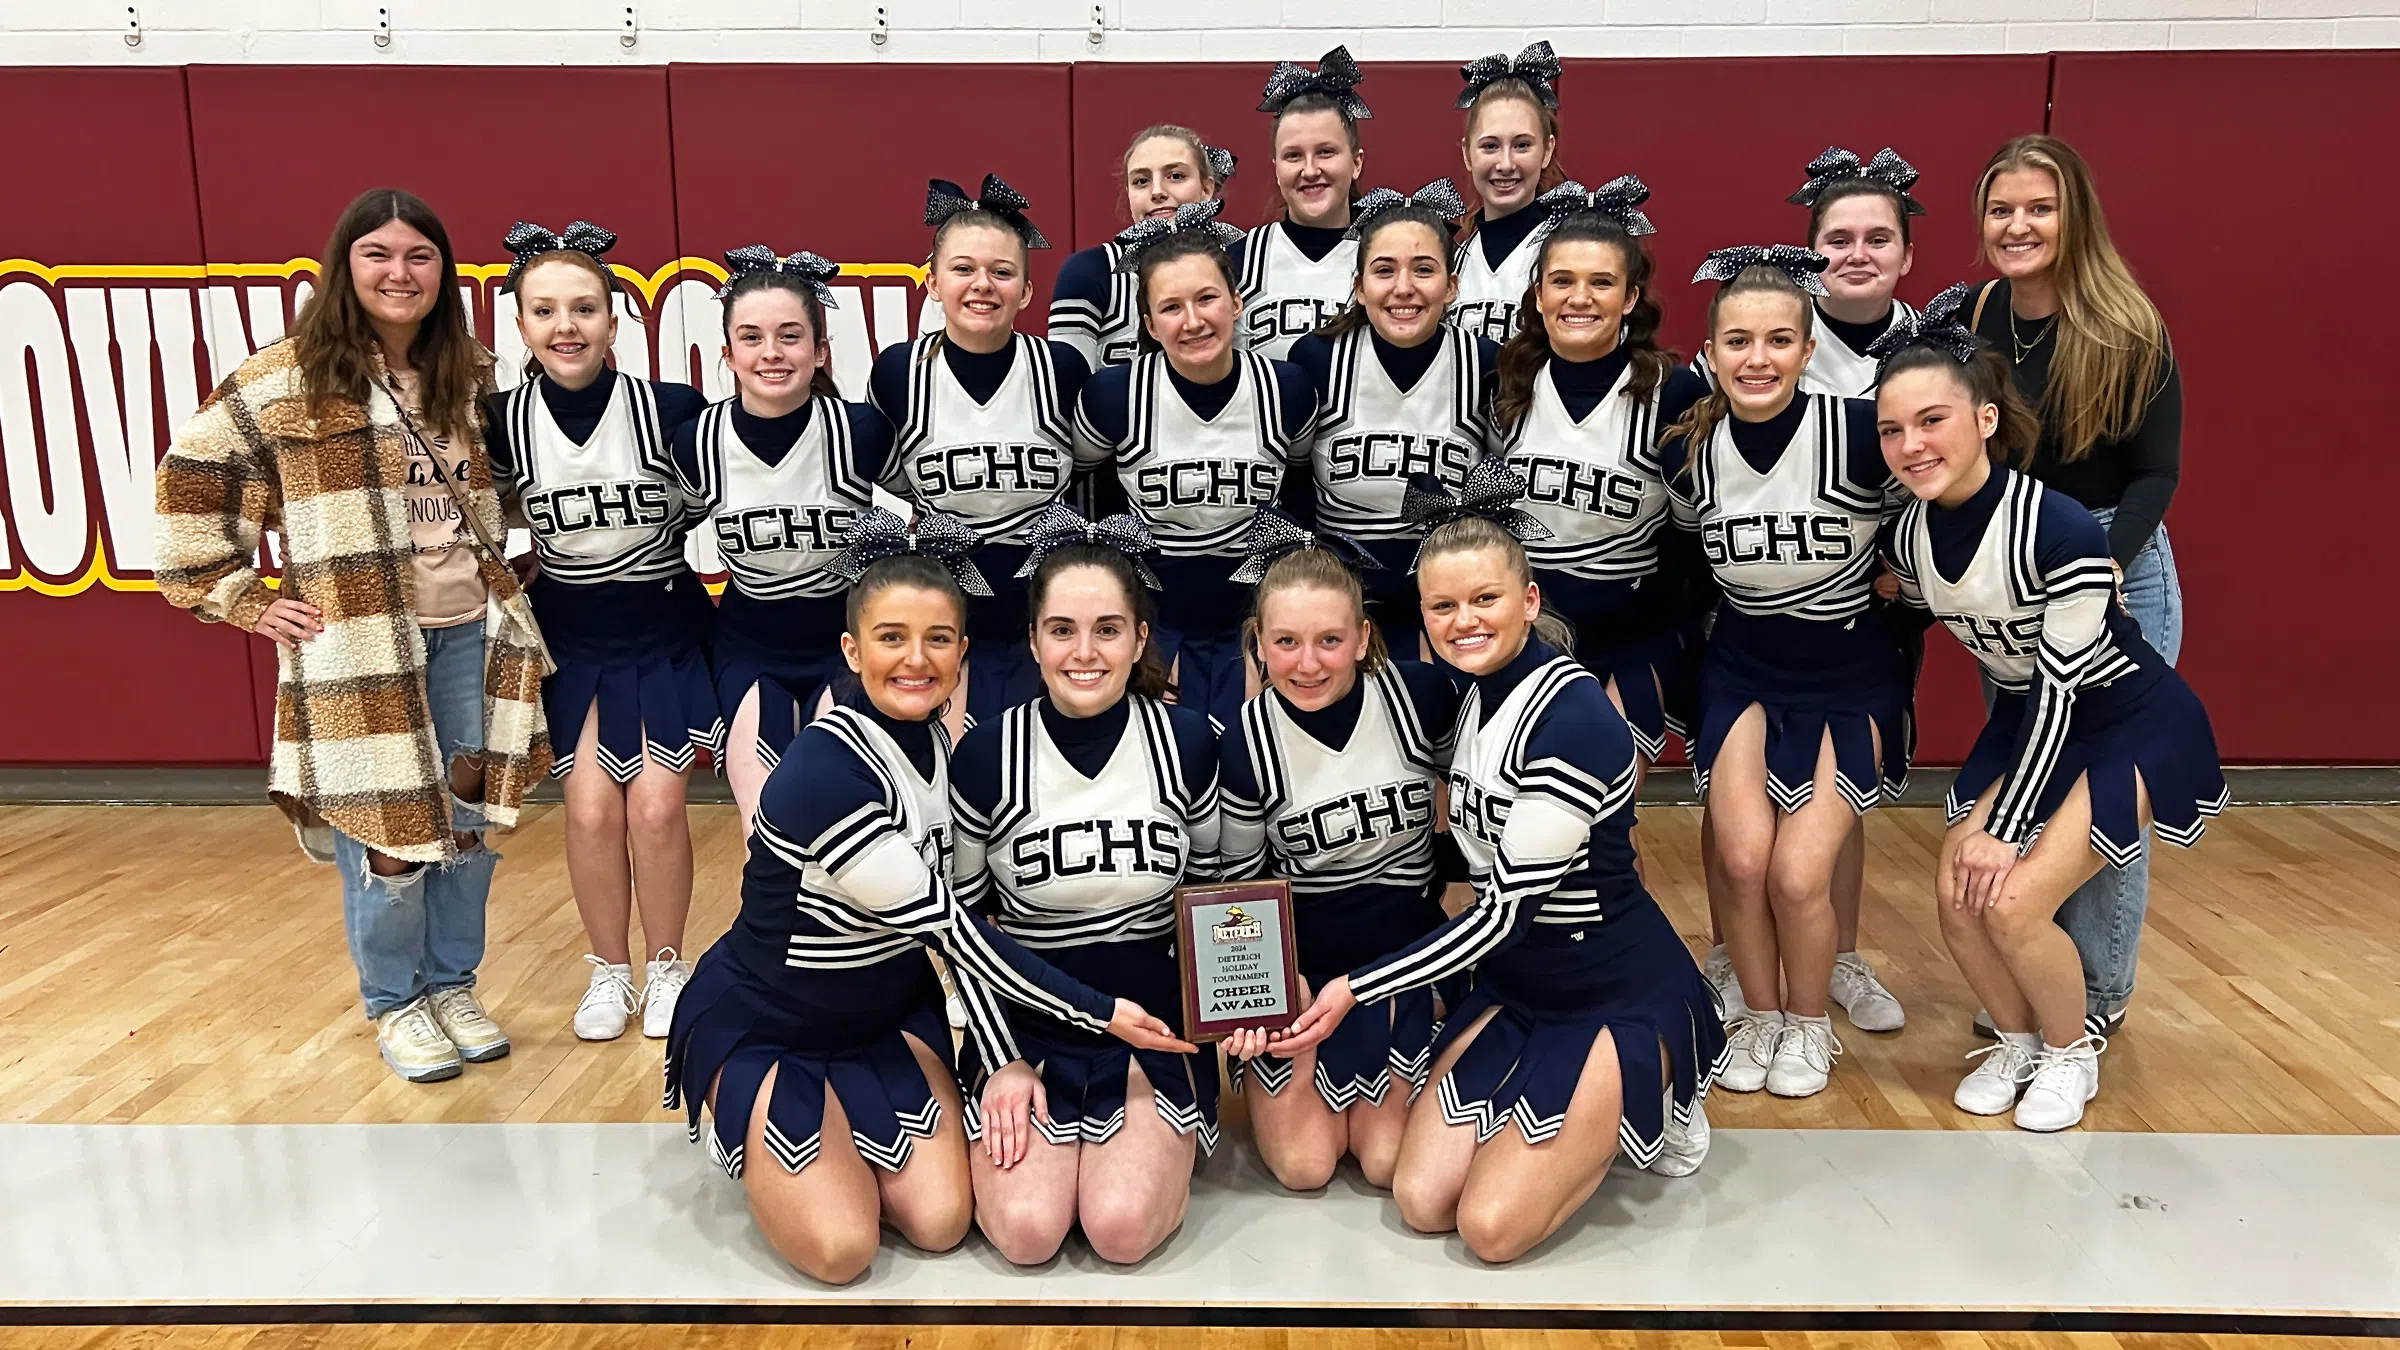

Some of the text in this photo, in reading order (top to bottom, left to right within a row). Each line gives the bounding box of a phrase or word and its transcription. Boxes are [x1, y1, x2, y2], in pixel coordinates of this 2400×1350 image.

[1247, 297, 1350, 350] SCH
[915, 446, 1061, 498] SCHS
[1136, 459, 1279, 508] SCHS
[1328, 432, 1471, 491] SCHS
[525, 481, 671, 536] SCHS
[1702, 513, 1855, 566] SCHS
[1276, 778, 1433, 858] SCHS
[1011, 818, 1182, 888] SCHS
[1217, 953, 1261, 963] DIETERICH
[1222, 963, 1259, 972] HOLIDAY
[1231, 945, 1247, 953] 2024
[1212, 972, 1270, 983] TOURNAMENT
[1213, 985, 1271, 998] CHEER
[1210, 997, 1277, 1012] AWARD
